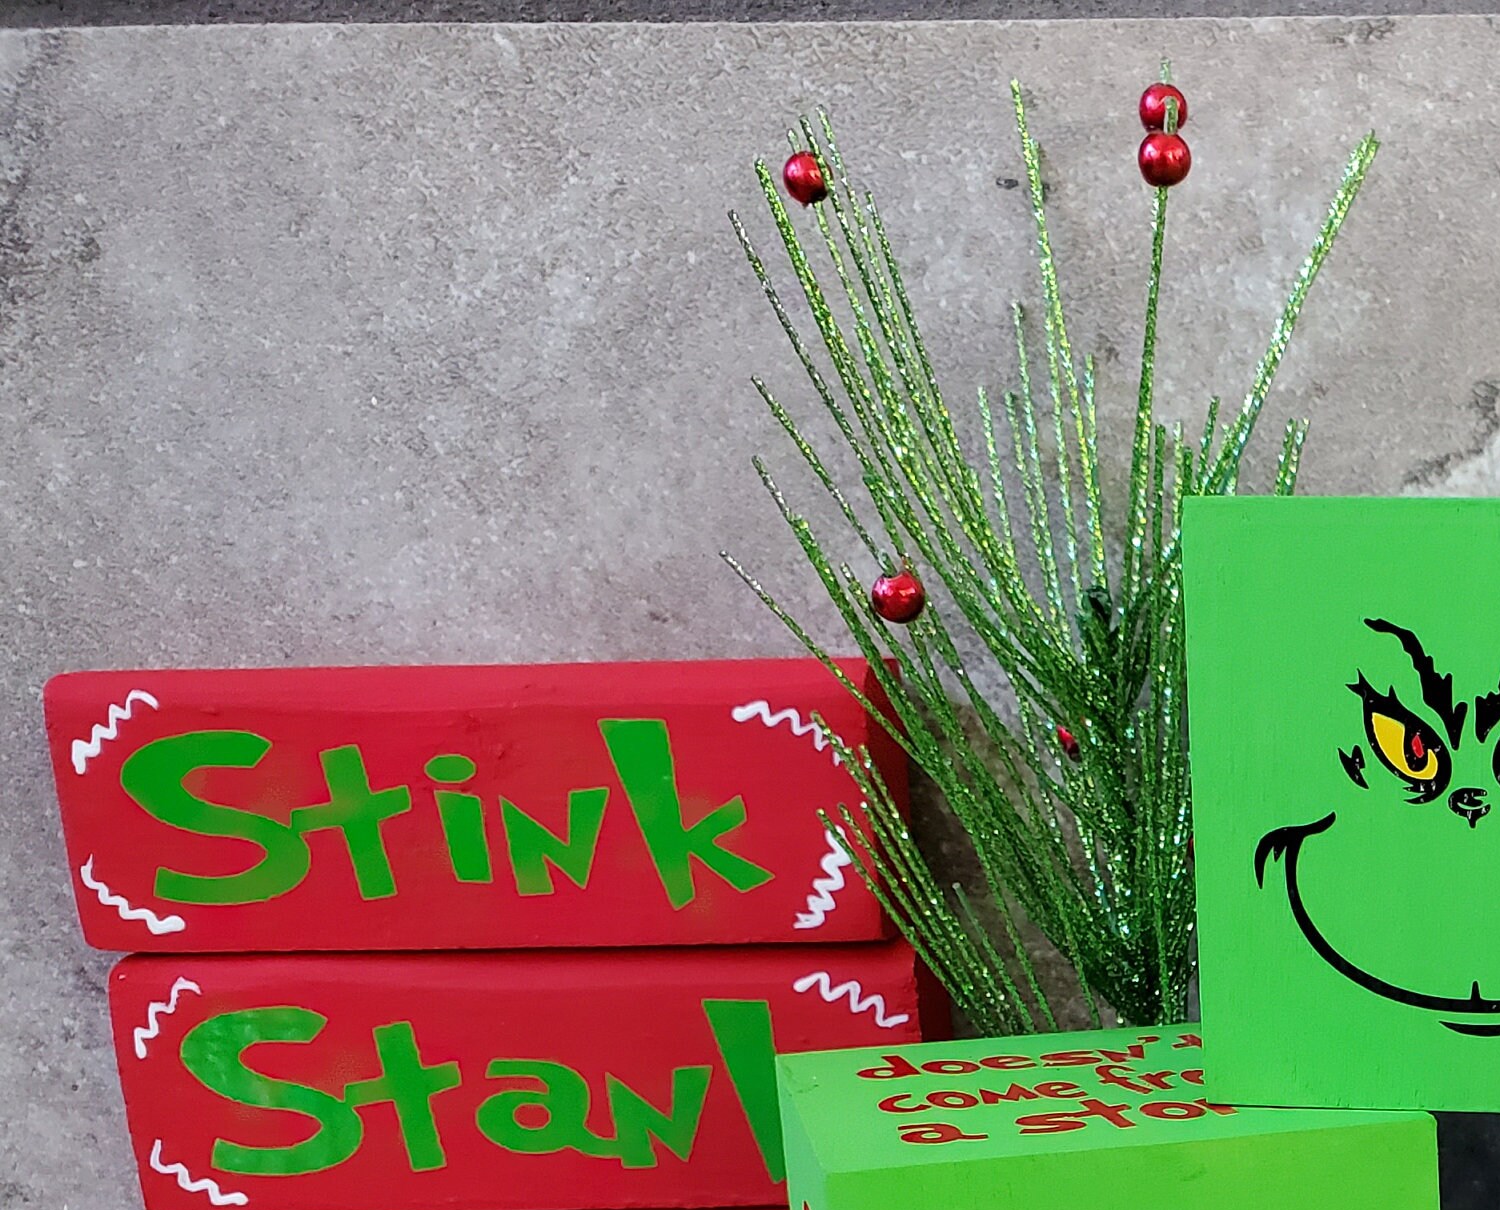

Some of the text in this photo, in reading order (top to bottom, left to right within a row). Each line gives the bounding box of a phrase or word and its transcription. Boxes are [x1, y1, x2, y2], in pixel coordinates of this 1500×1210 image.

[121, 718, 775, 910] Stink
[878, 1081, 1088, 1114] come
[897, 1123, 989, 1144] a
